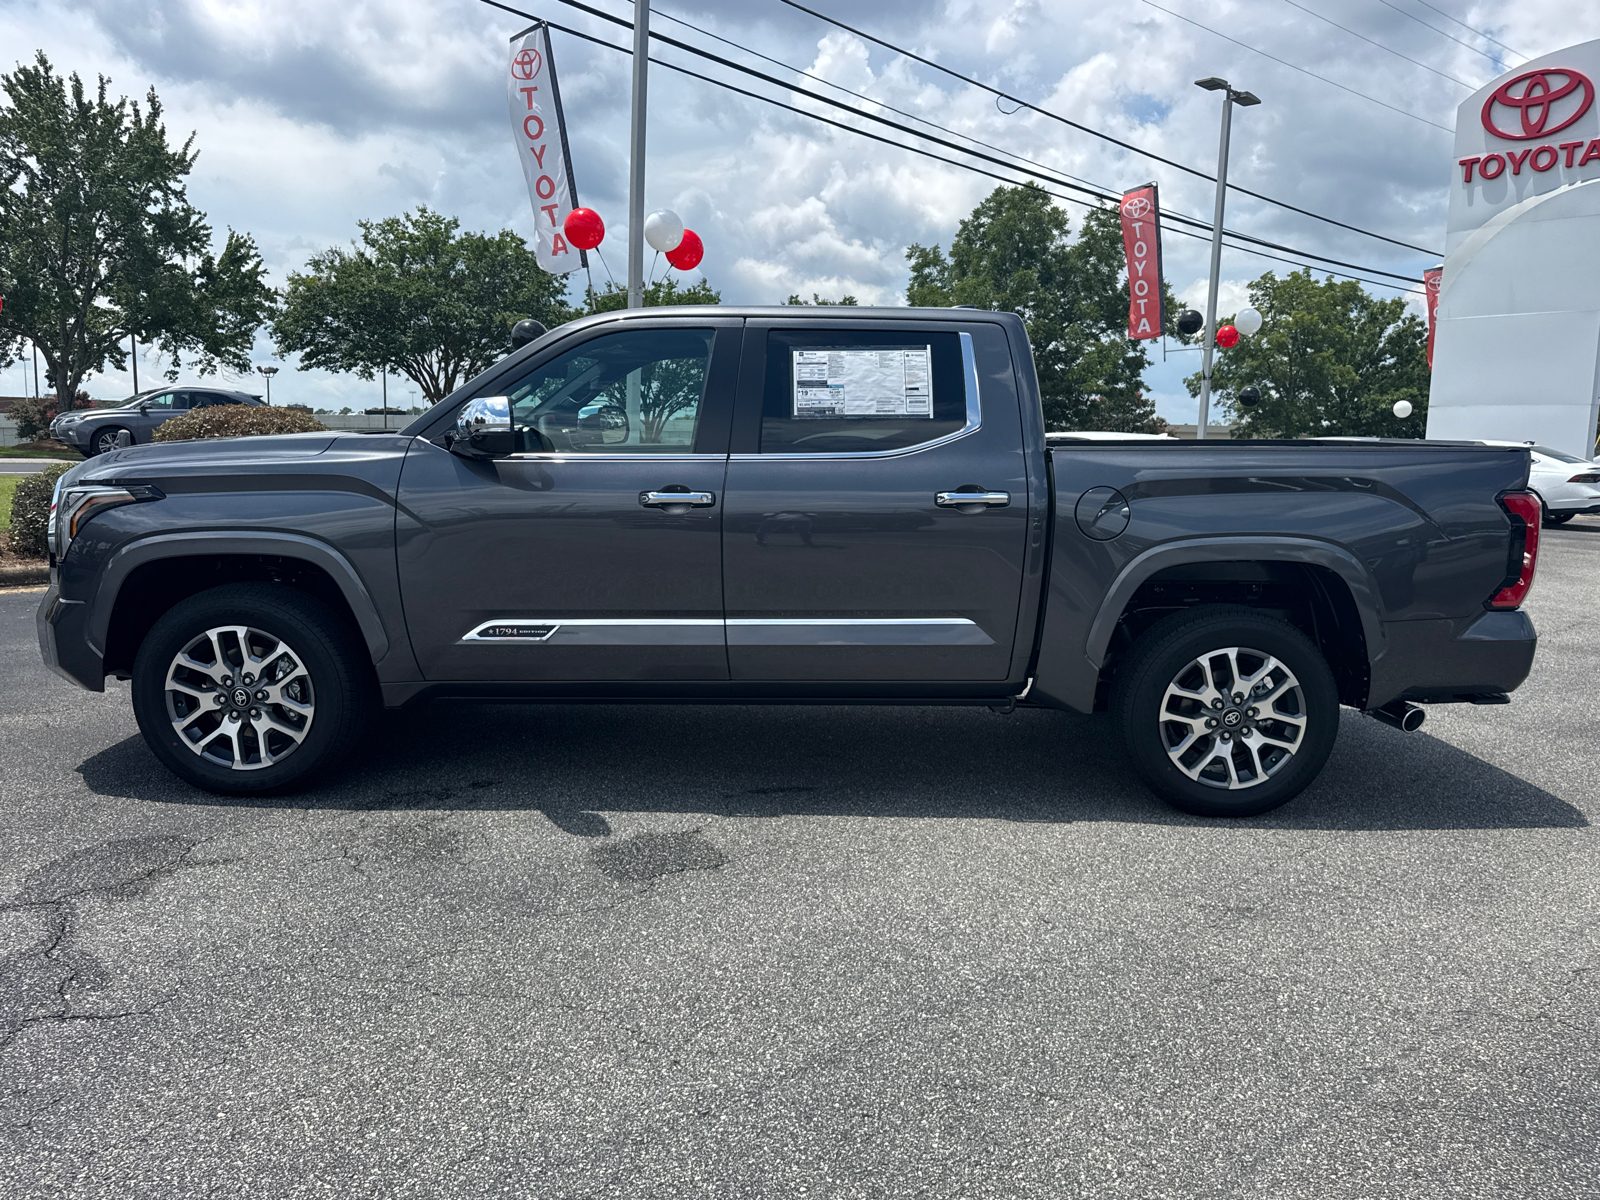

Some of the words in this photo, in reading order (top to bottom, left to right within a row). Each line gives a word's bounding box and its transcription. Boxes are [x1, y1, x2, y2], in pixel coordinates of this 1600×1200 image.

[519, 86, 569, 256] TOYOTA
[1458, 138, 1600, 183] TOYOTA
[1131, 221, 1151, 334] TOYOTA
